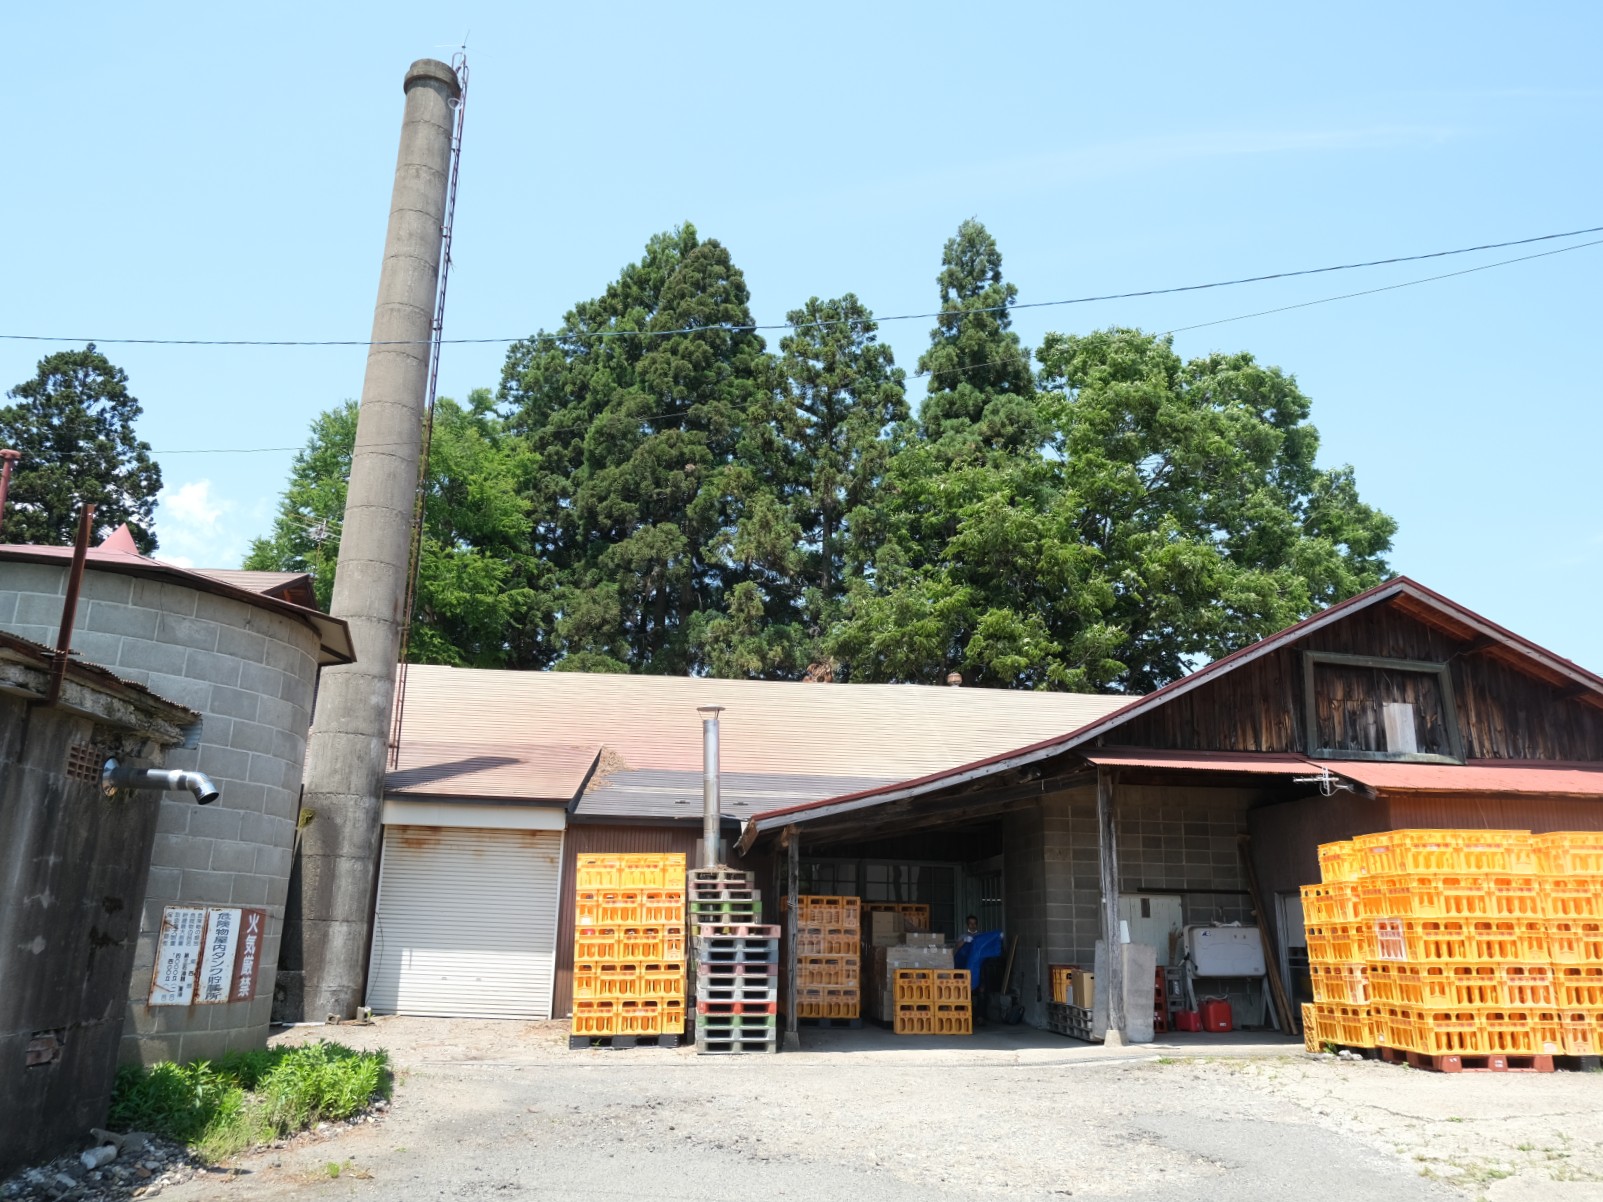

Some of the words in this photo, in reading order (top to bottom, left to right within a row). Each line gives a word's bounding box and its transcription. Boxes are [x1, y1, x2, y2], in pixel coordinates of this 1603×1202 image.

[204, 912, 232, 1000] 危険物屋内タンク貯蔵所
[237, 912, 260, 997] 火気厳禁
